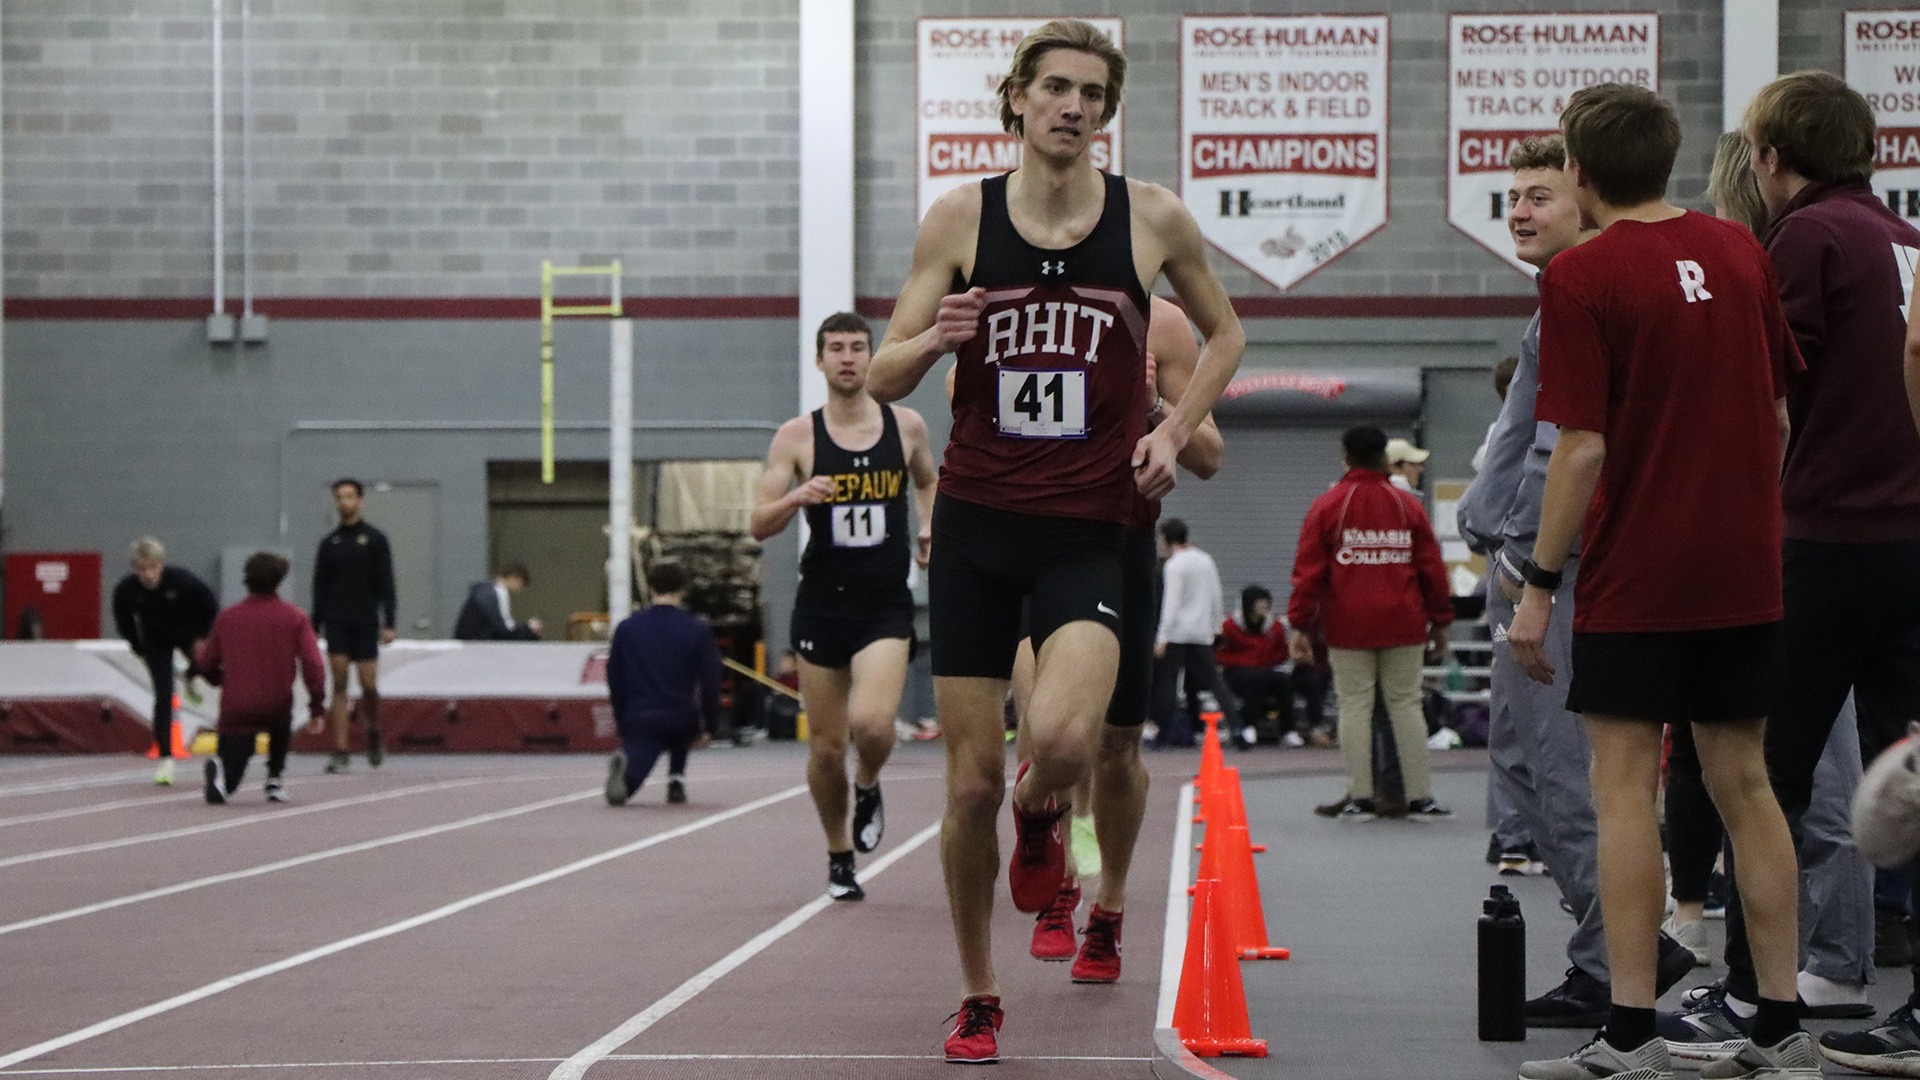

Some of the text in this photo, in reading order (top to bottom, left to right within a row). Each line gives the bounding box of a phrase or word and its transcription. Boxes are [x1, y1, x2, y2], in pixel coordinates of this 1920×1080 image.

[1201, 72, 1369, 92] MEN'S INDOOR
[1457, 68, 1650, 88] MEN'S OUTDOOR
[1200, 98, 1371, 118] TRACK & FIELD
[1467, 96, 1544, 115] TRACK
[1194, 138, 1376, 170] CHAMPIONS
[1675, 259, 1714, 304] R
[984, 301, 1115, 364] RHIT
[1013, 372, 1064, 423] 41
[843, 507, 872, 537] 11
